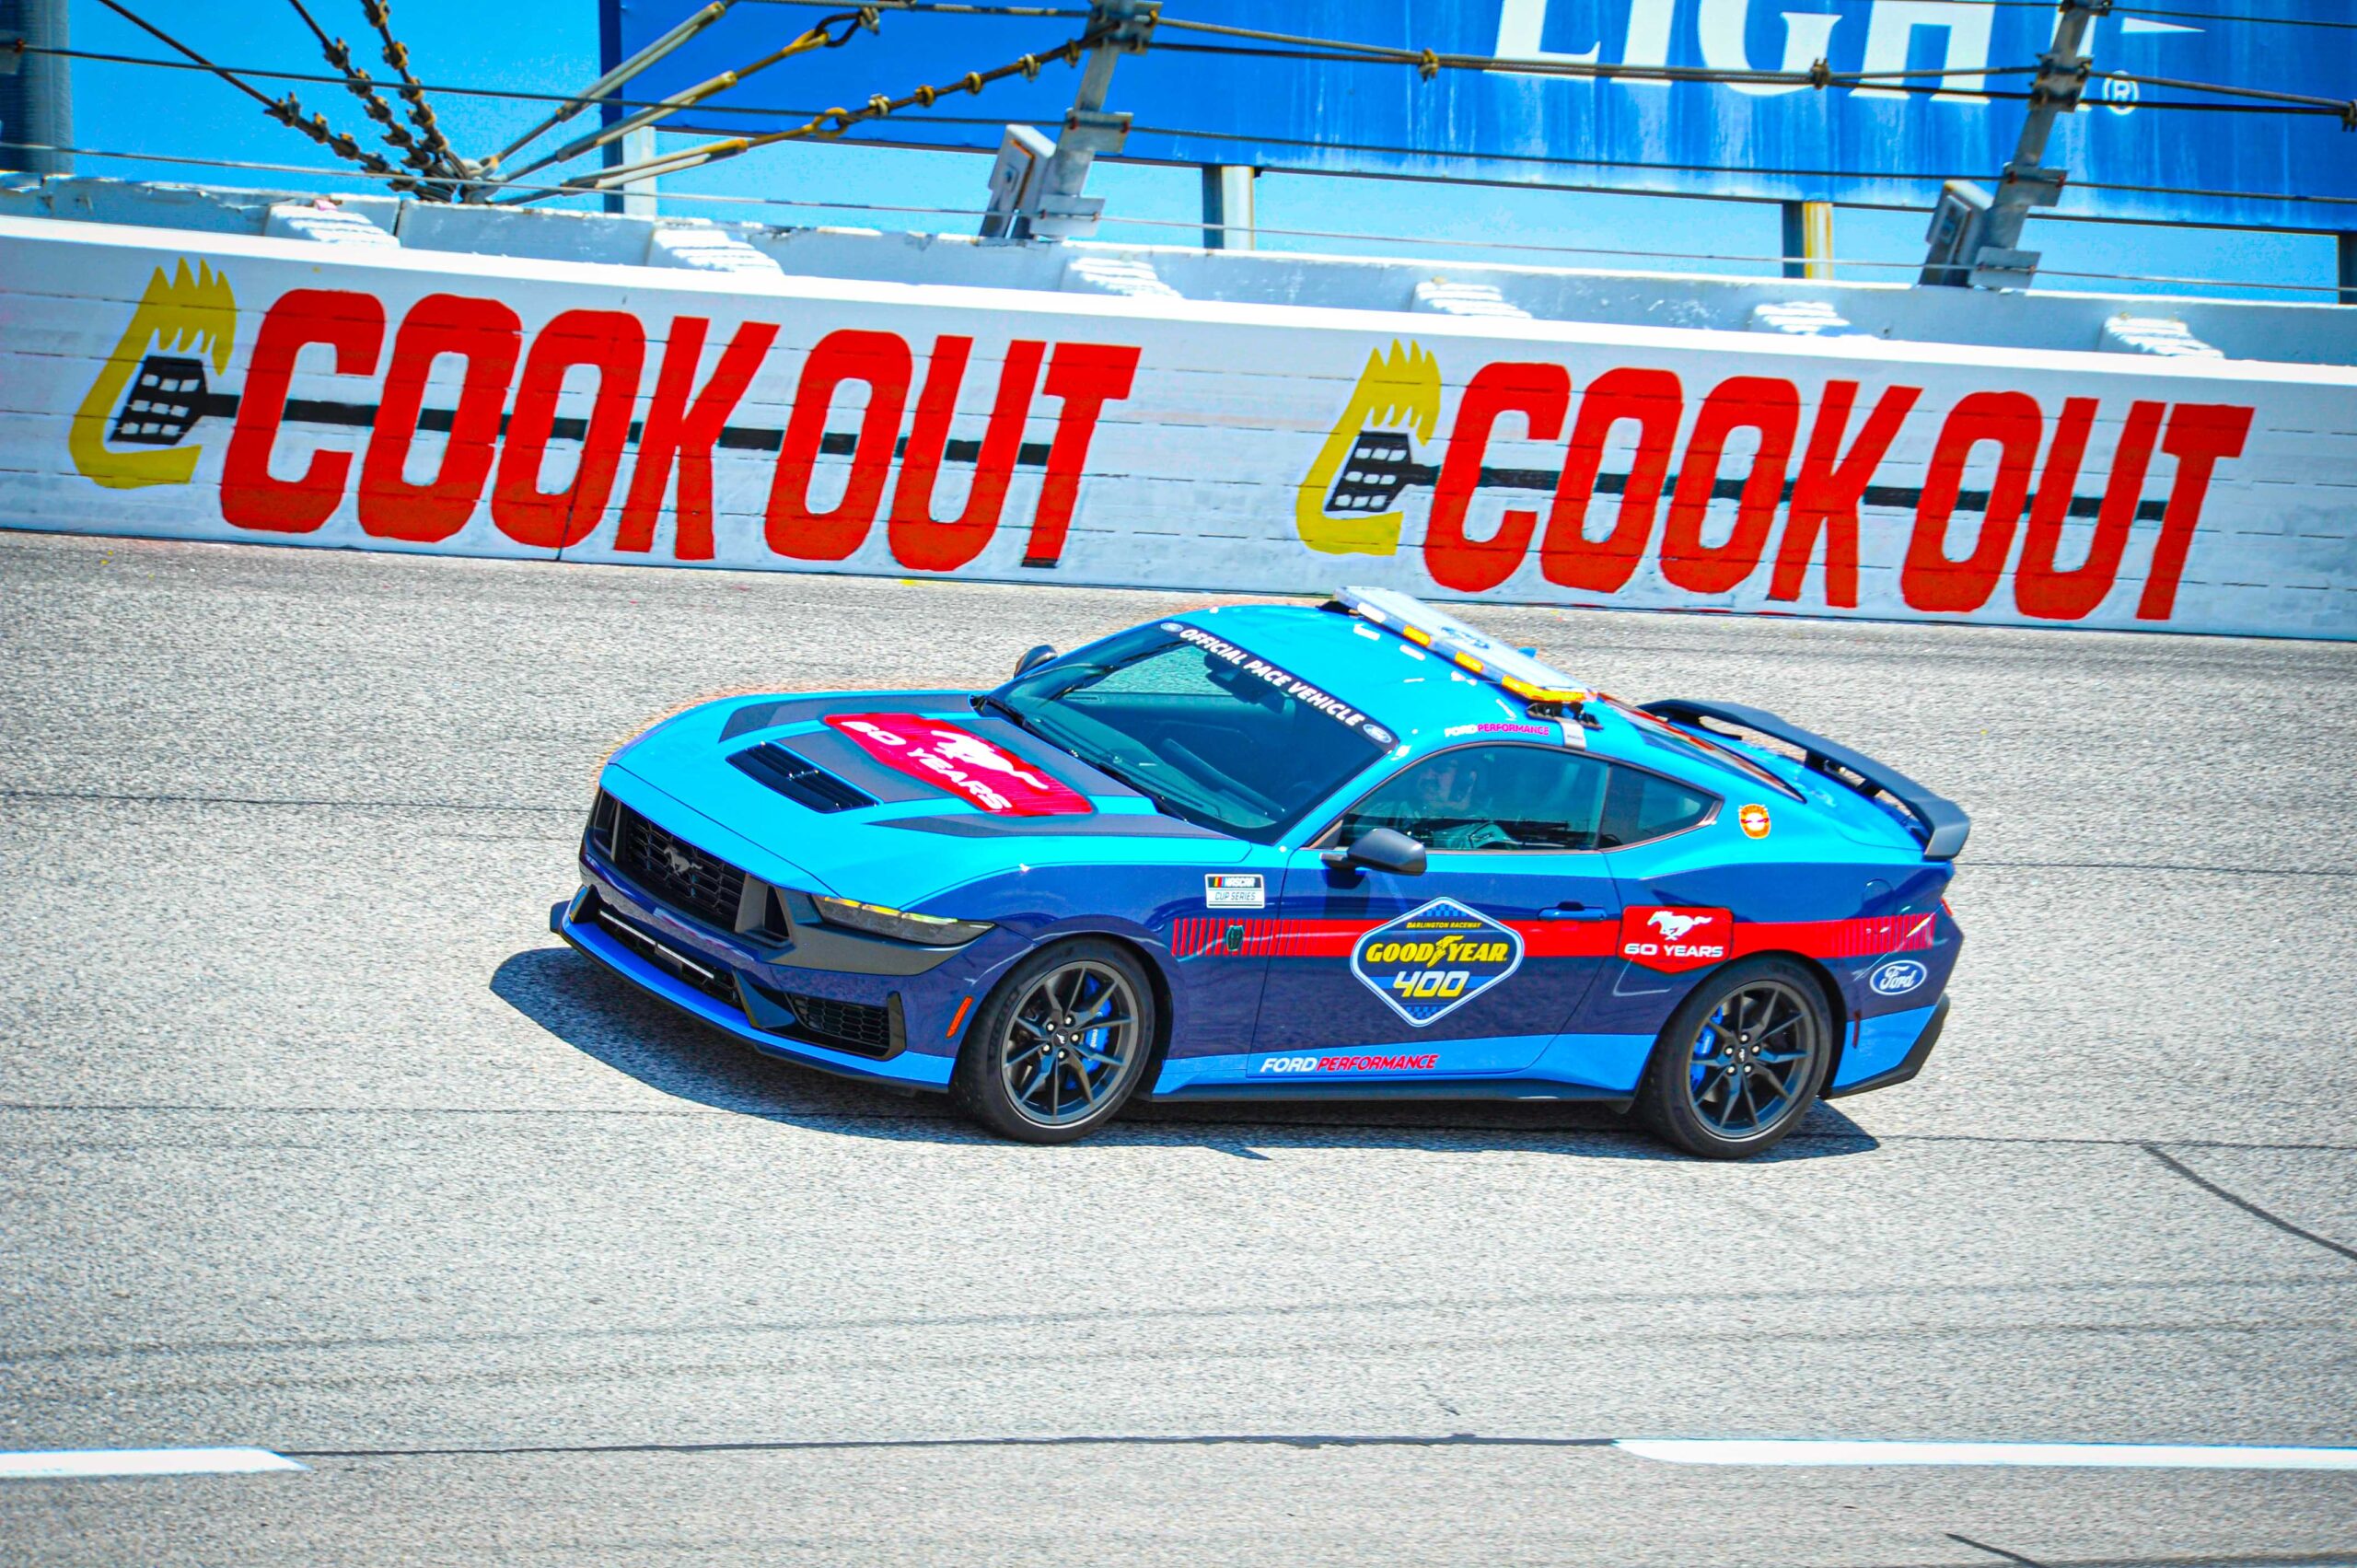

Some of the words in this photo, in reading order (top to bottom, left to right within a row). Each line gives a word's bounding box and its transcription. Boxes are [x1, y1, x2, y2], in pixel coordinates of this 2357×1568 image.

[220, 288, 781, 560] COOK
[764, 329, 1142, 572] OUT
[1423, 362, 1923, 608] COOK
[1900, 391, 2255, 621] OUT
[1179, 628, 1248, 666] OFFICIAL
[1243, 659, 1292, 688] PACE
[1286, 680, 1365, 726] VEHICLE
[1477, 723, 1550, 736] PERFORMANCE
[841, 721, 907, 746] 60
[907, 748, 1013, 810] YEARS
[1214, 891, 1230, 900] CUP
[1230, 891, 1256, 900] SERIES
[1624, 943, 1658, 956] 60
[1663, 945, 1724, 958] YEARS
[1392, 970, 1470, 998] 400
[1878, 965, 1918, 991] Ford
[1260, 1057, 1318, 1073] FORD
[1317, 1054, 1440, 1072] PERFORMANCE
